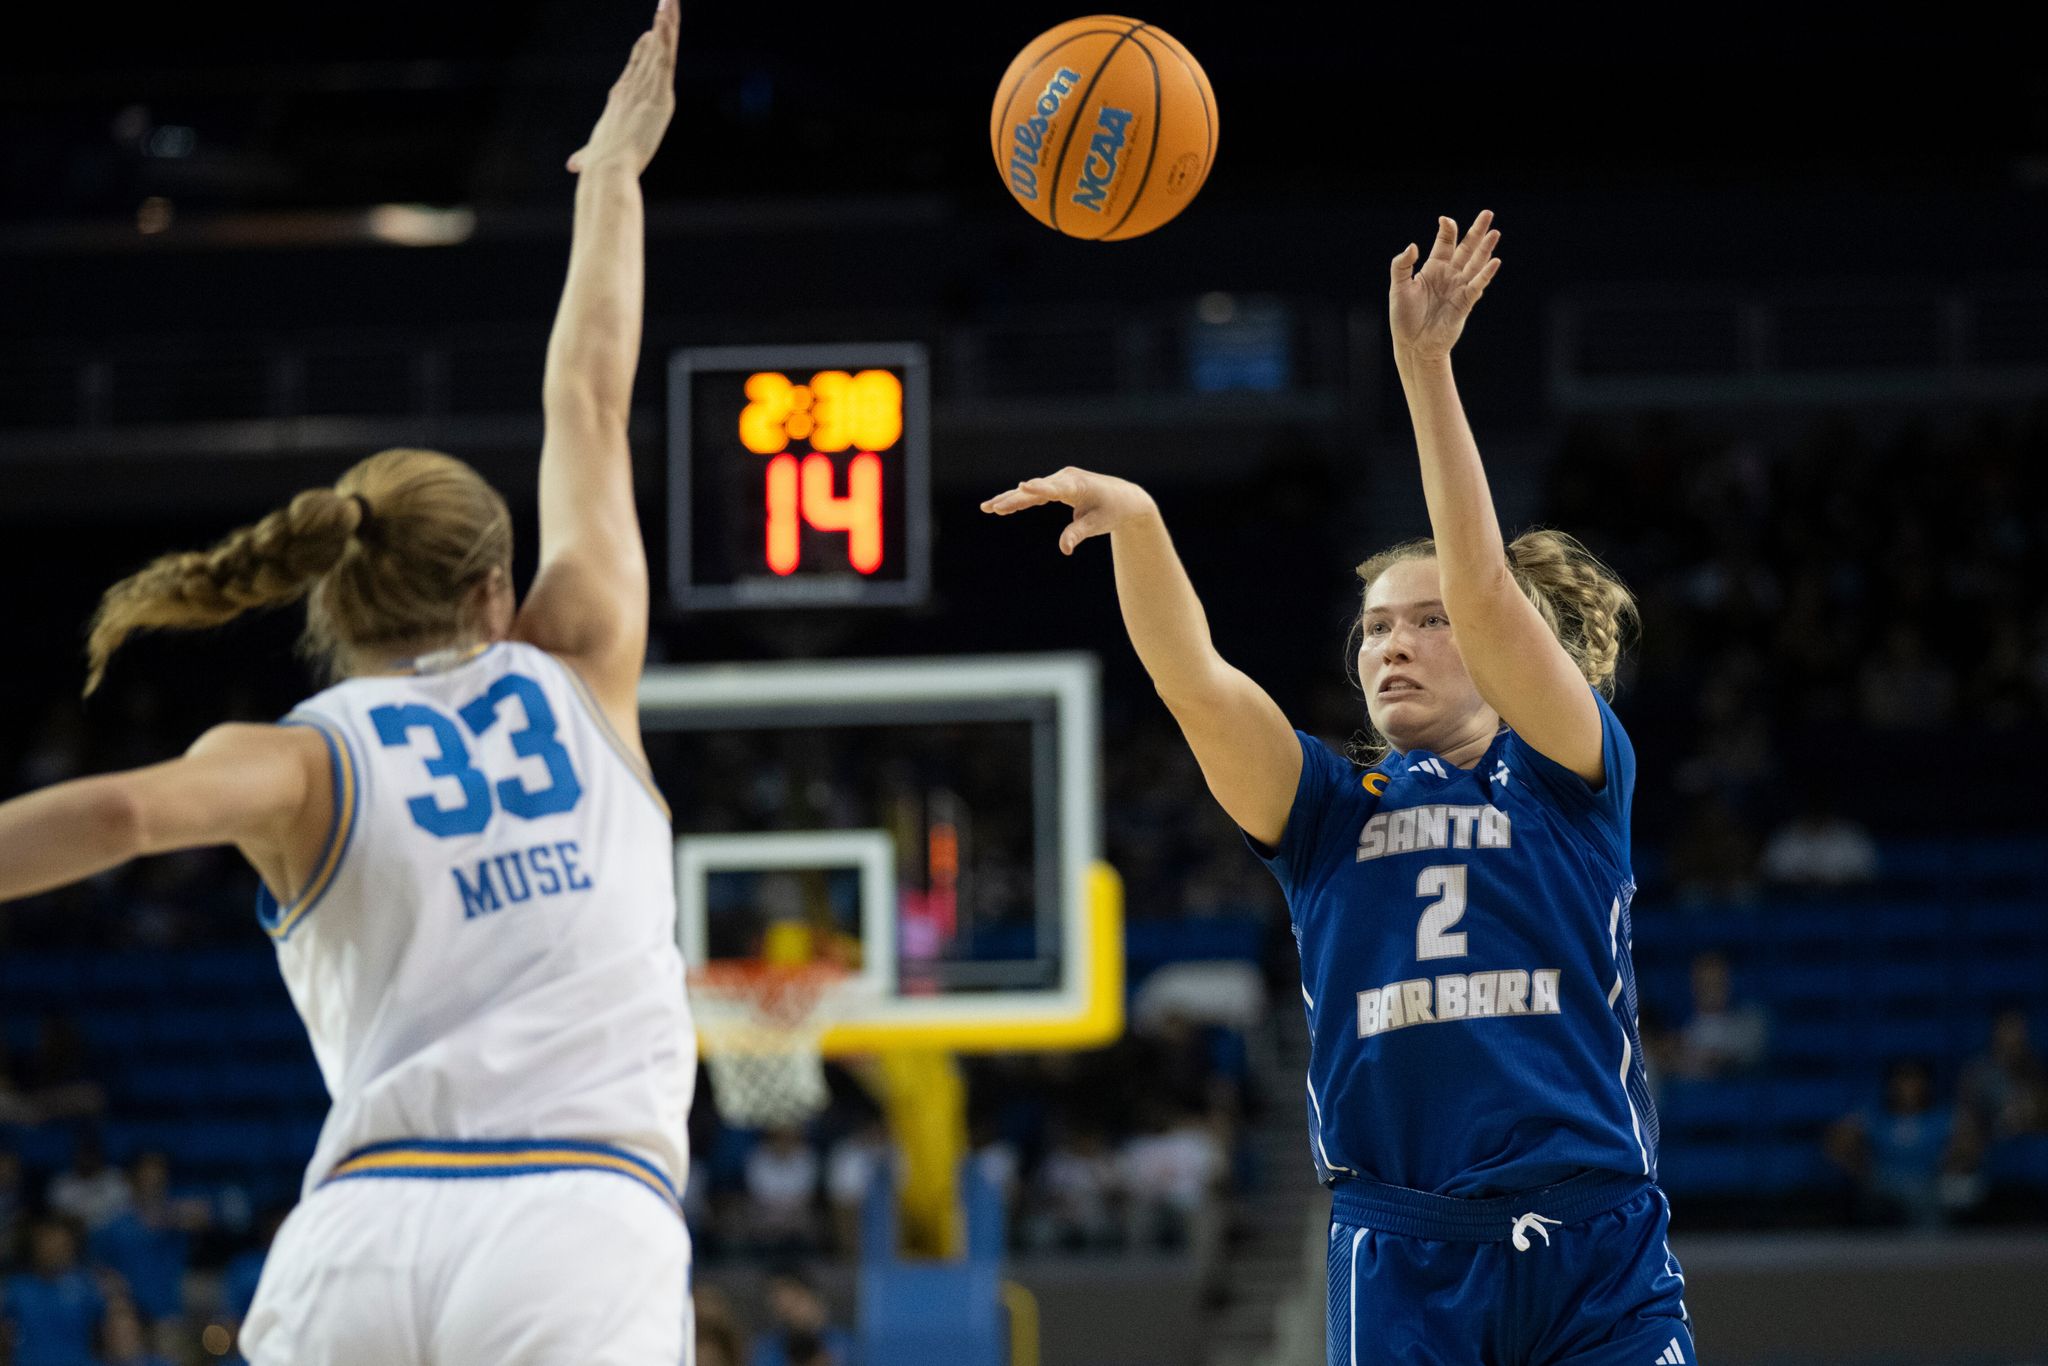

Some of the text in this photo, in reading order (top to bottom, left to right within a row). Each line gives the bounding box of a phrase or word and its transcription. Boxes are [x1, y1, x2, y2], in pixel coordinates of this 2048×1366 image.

[1010, 67, 1081, 201] Wilson
[1071, 106, 1133, 213] NCAA
[766, 451, 883, 576] 14
[368, 673, 582, 837] 33
[452, 841, 592, 919] MUSE
[1356, 804, 1511, 862] SANTA
[1416, 864, 1467, 961] 2
[1357, 968, 1560, 1038] BARBARA
